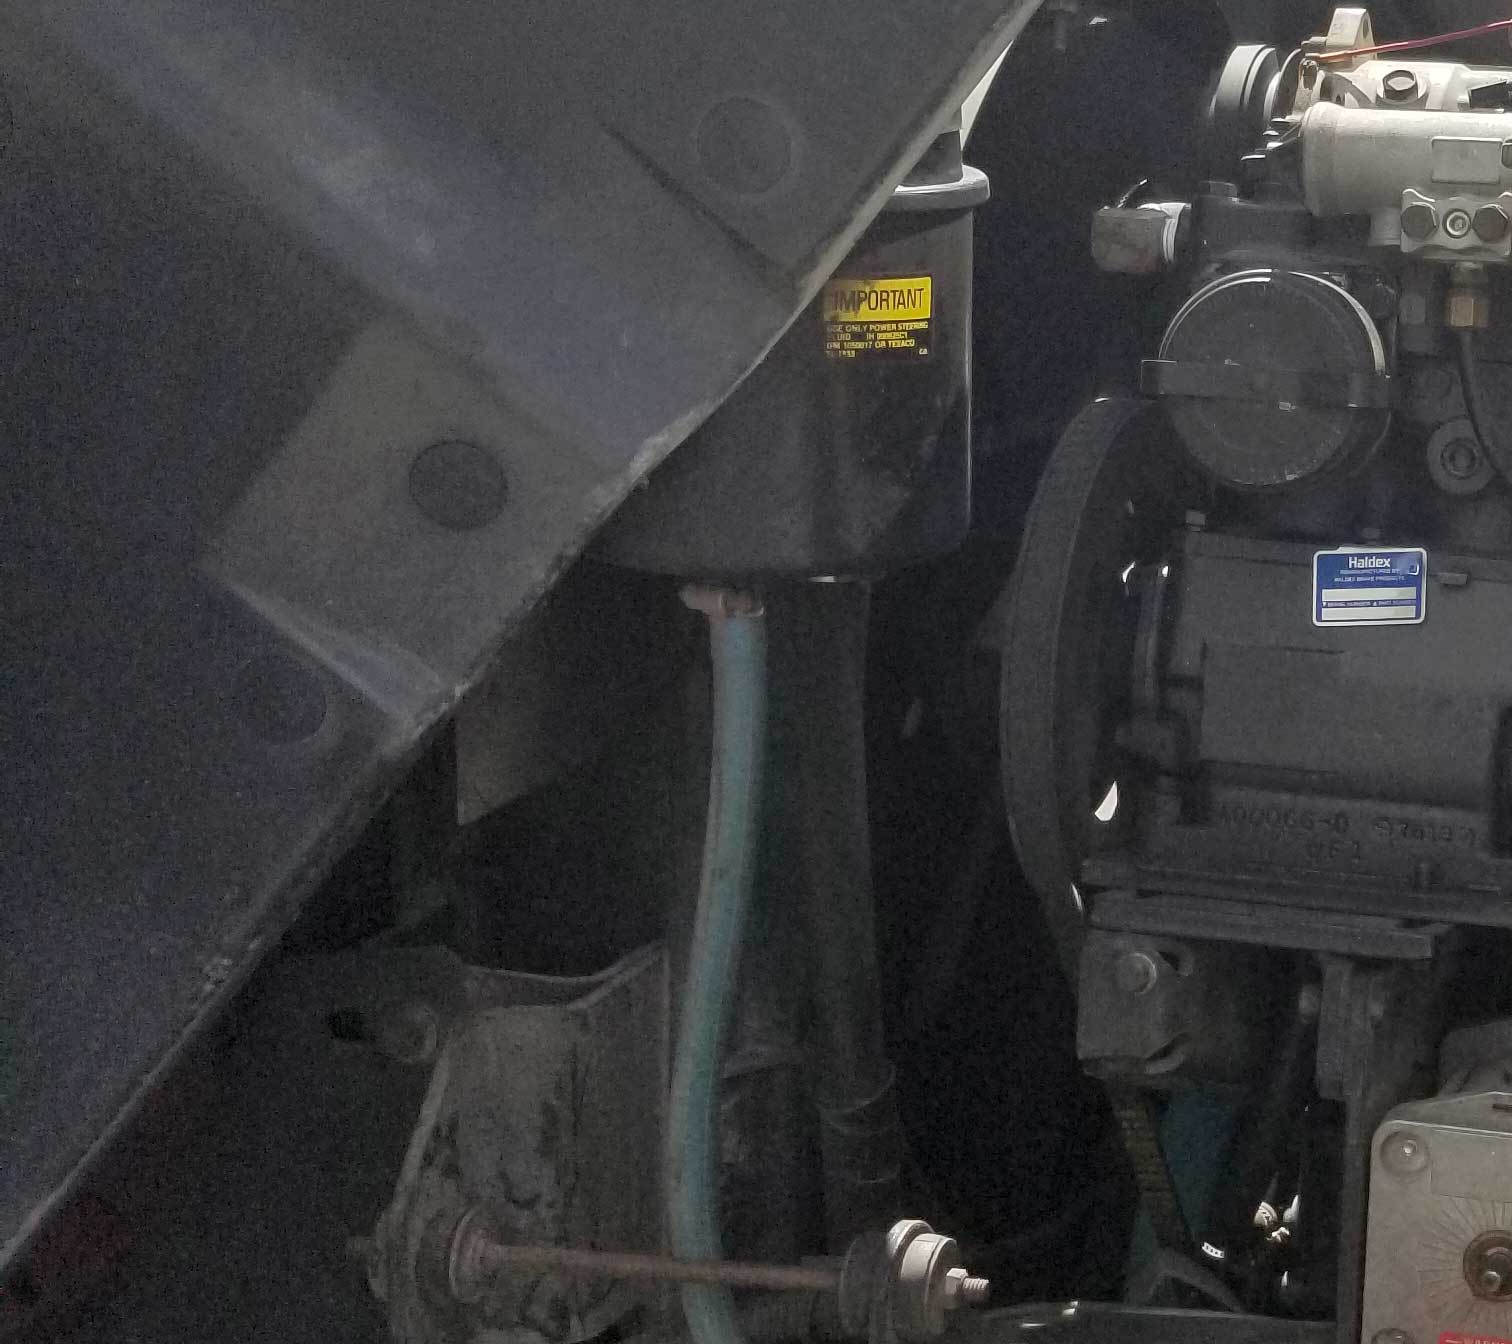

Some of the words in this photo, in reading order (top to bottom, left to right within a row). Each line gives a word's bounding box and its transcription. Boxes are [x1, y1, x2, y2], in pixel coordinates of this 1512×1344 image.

[833, 288, 925, 313] IMPORTANT
[845, 325, 869, 333] ONLY
[869, 323, 897, 332] POWER
[1348, 556, 1391, 569] Haldex
